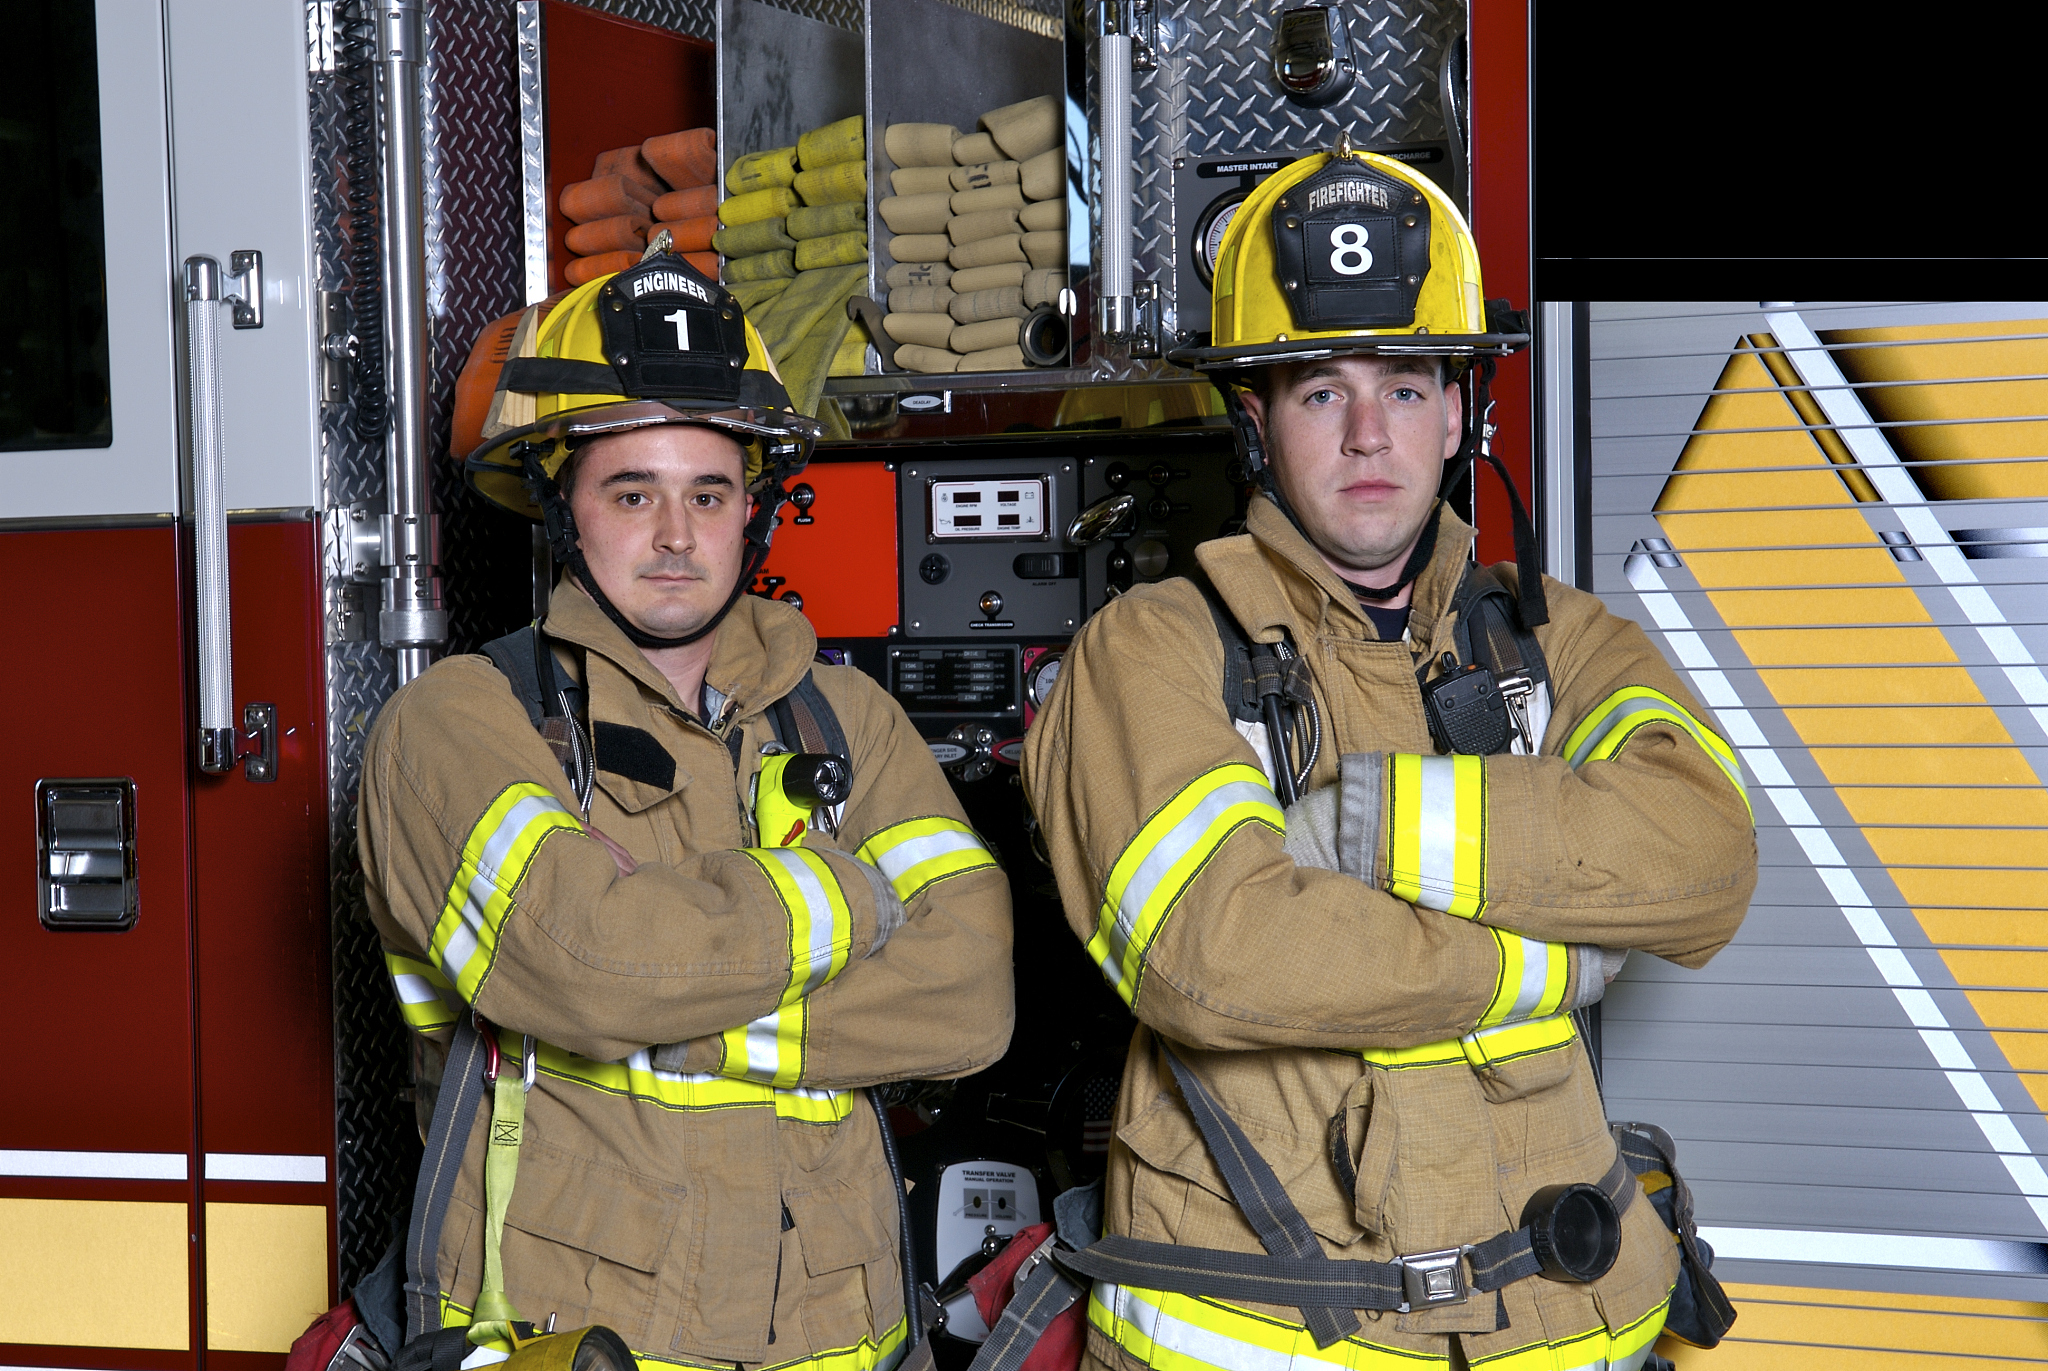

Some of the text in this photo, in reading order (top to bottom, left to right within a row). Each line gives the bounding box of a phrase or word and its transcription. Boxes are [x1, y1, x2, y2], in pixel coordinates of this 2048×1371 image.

[1216, 161, 1279, 173] MASTER INTAKE
[1307, 180, 1391, 212] FIREFIGHTER
[1329, 223, 1374, 276] 8
[633, 272, 709, 303] ENGINEER
[663, 309, 690, 351] 1
